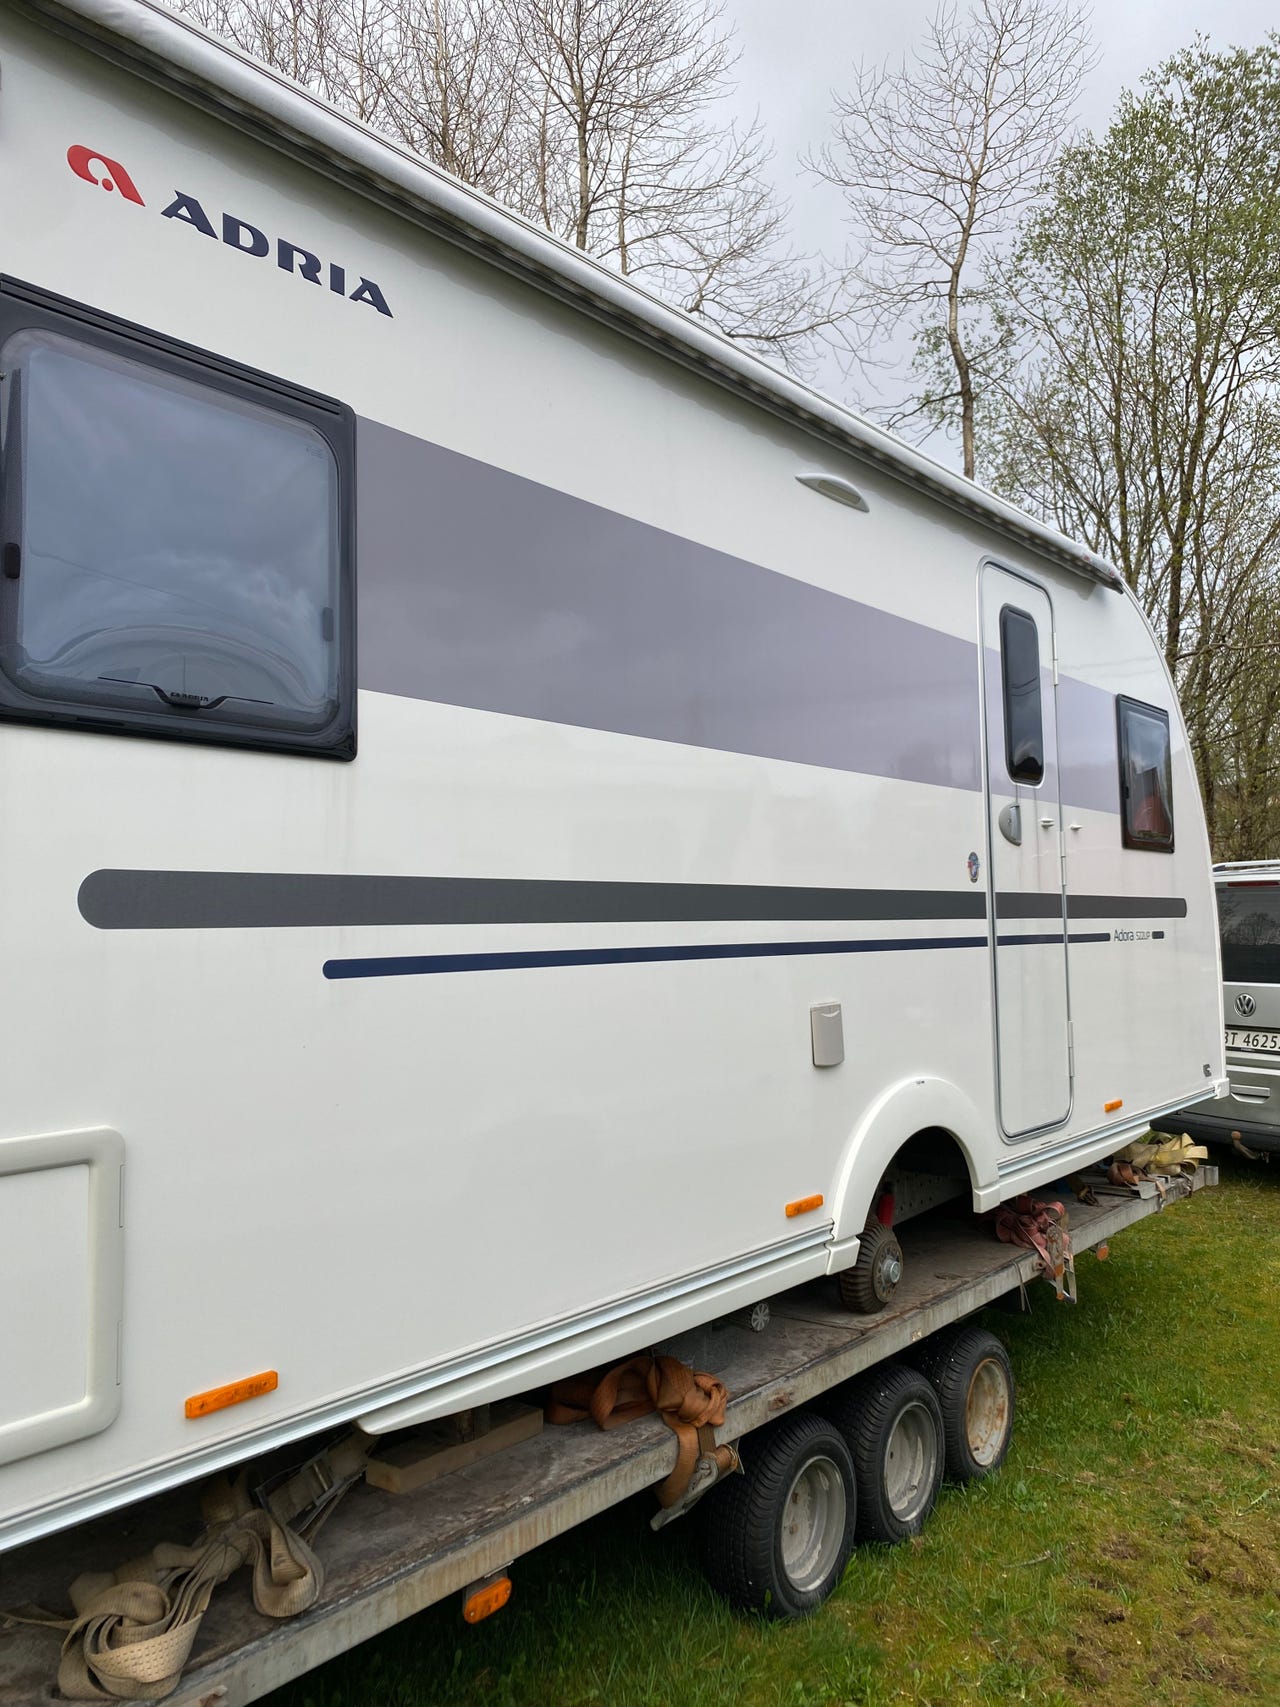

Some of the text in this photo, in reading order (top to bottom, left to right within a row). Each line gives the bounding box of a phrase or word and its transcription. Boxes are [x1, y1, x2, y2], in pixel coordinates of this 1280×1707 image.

[161, 190, 393, 318] ADRIA
[1113, 928, 1134, 942] Adora
[1243, 1033, 1280, 1049] 4625
